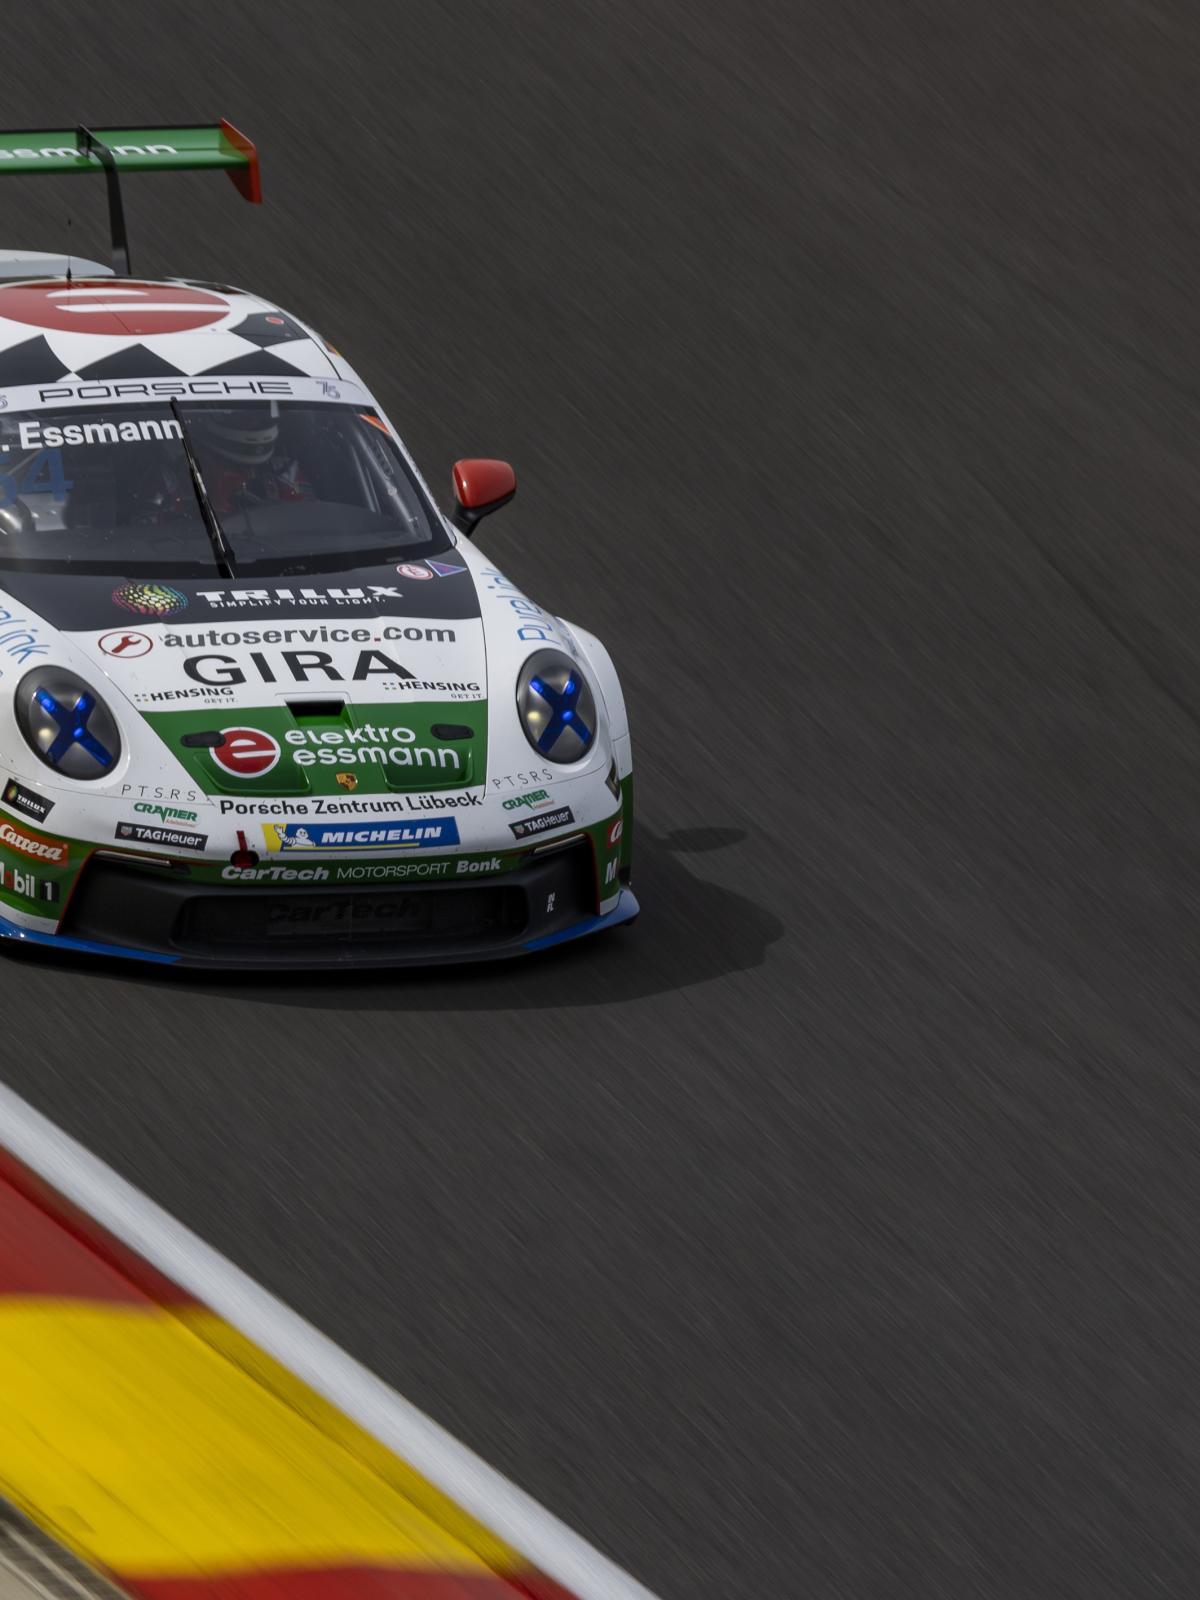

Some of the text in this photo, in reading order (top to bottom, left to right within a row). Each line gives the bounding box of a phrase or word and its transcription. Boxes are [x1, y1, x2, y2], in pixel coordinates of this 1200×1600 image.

[38, 380, 294, 402] PORSCHE
[18, 418, 185, 450] Essmann
[196, 586, 404, 602] TRILUX
[209, 598, 281, 609] SIMPLIFY
[289, 598, 329, 606] YOUR
[164, 625, 457, 649] autoservice.com
[183, 649, 418, 687] GIRA
[150, 686, 235, 702] HENSING
[398, 681, 481, 692] HENSING
[284, 723, 417, 745] elektro
[292, 746, 460, 770] essmann
[16, 794, 47, 814] TRILUX
[220, 791, 483, 816] Porsche Zentrum Lübeck
[502, 789, 550, 811] CRAMER
[133, 802, 199, 824] CRAMER
[0, 823, 64, 860] Carrera
[321, 826, 442, 844] MICHELIN
[221, 856, 503, 881] CarTech MOTORSPORT Bonk
[44, 881, 54, 901] 1
